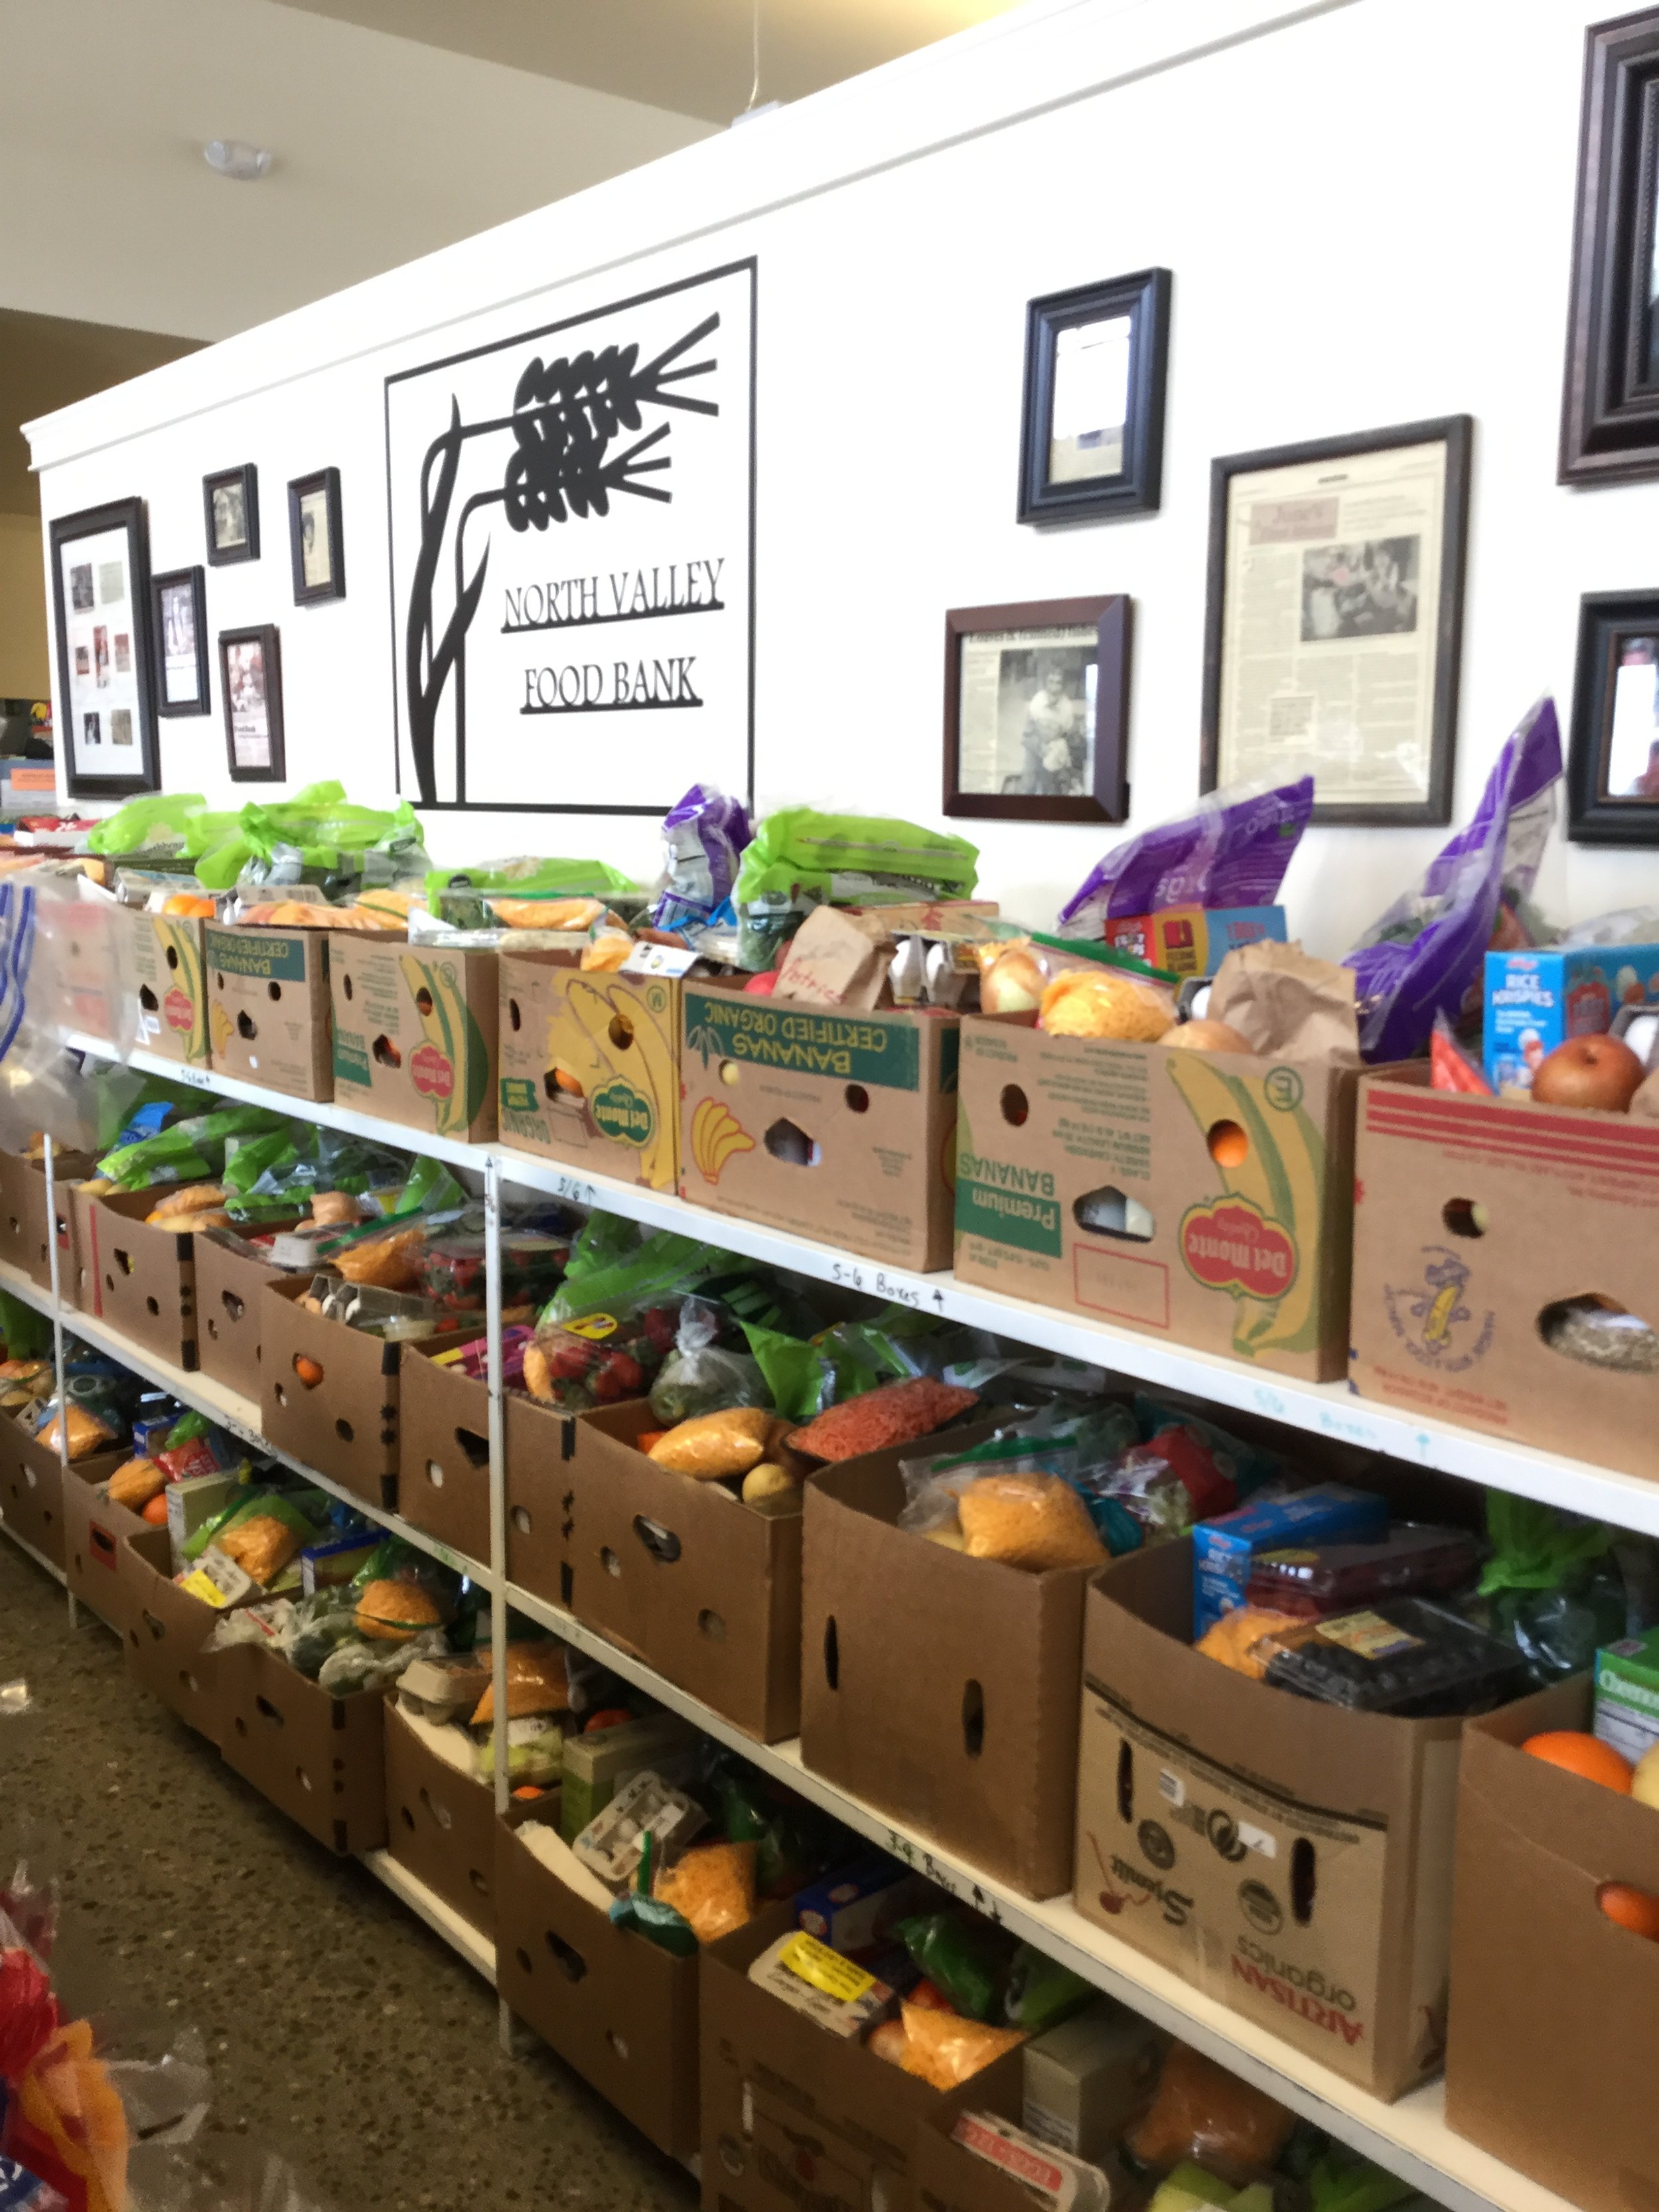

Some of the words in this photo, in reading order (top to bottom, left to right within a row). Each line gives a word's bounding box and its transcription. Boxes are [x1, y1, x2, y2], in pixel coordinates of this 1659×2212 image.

[505, 575, 599, 628] NORTH
[609, 557, 725, 614] VALLEY
[524, 664, 603, 707] FOOD
[613, 656, 699, 705] BANK
[703, 1001, 778, 1037] ORGANIC
[781, 1016, 888, 1053] CERTIFIED
[732, 1033, 851, 1075] BANANAS
[959, 1152, 1055, 1197] BANANAS
[972, 1187, 1055, 1232] Premium
[1188, 1232, 1252, 1270] Monte
[1254, 1246, 1288, 1279] Del
[1236, 1934, 1356, 2012] organics
[1231, 1953, 1364, 2046] ARTISAN
